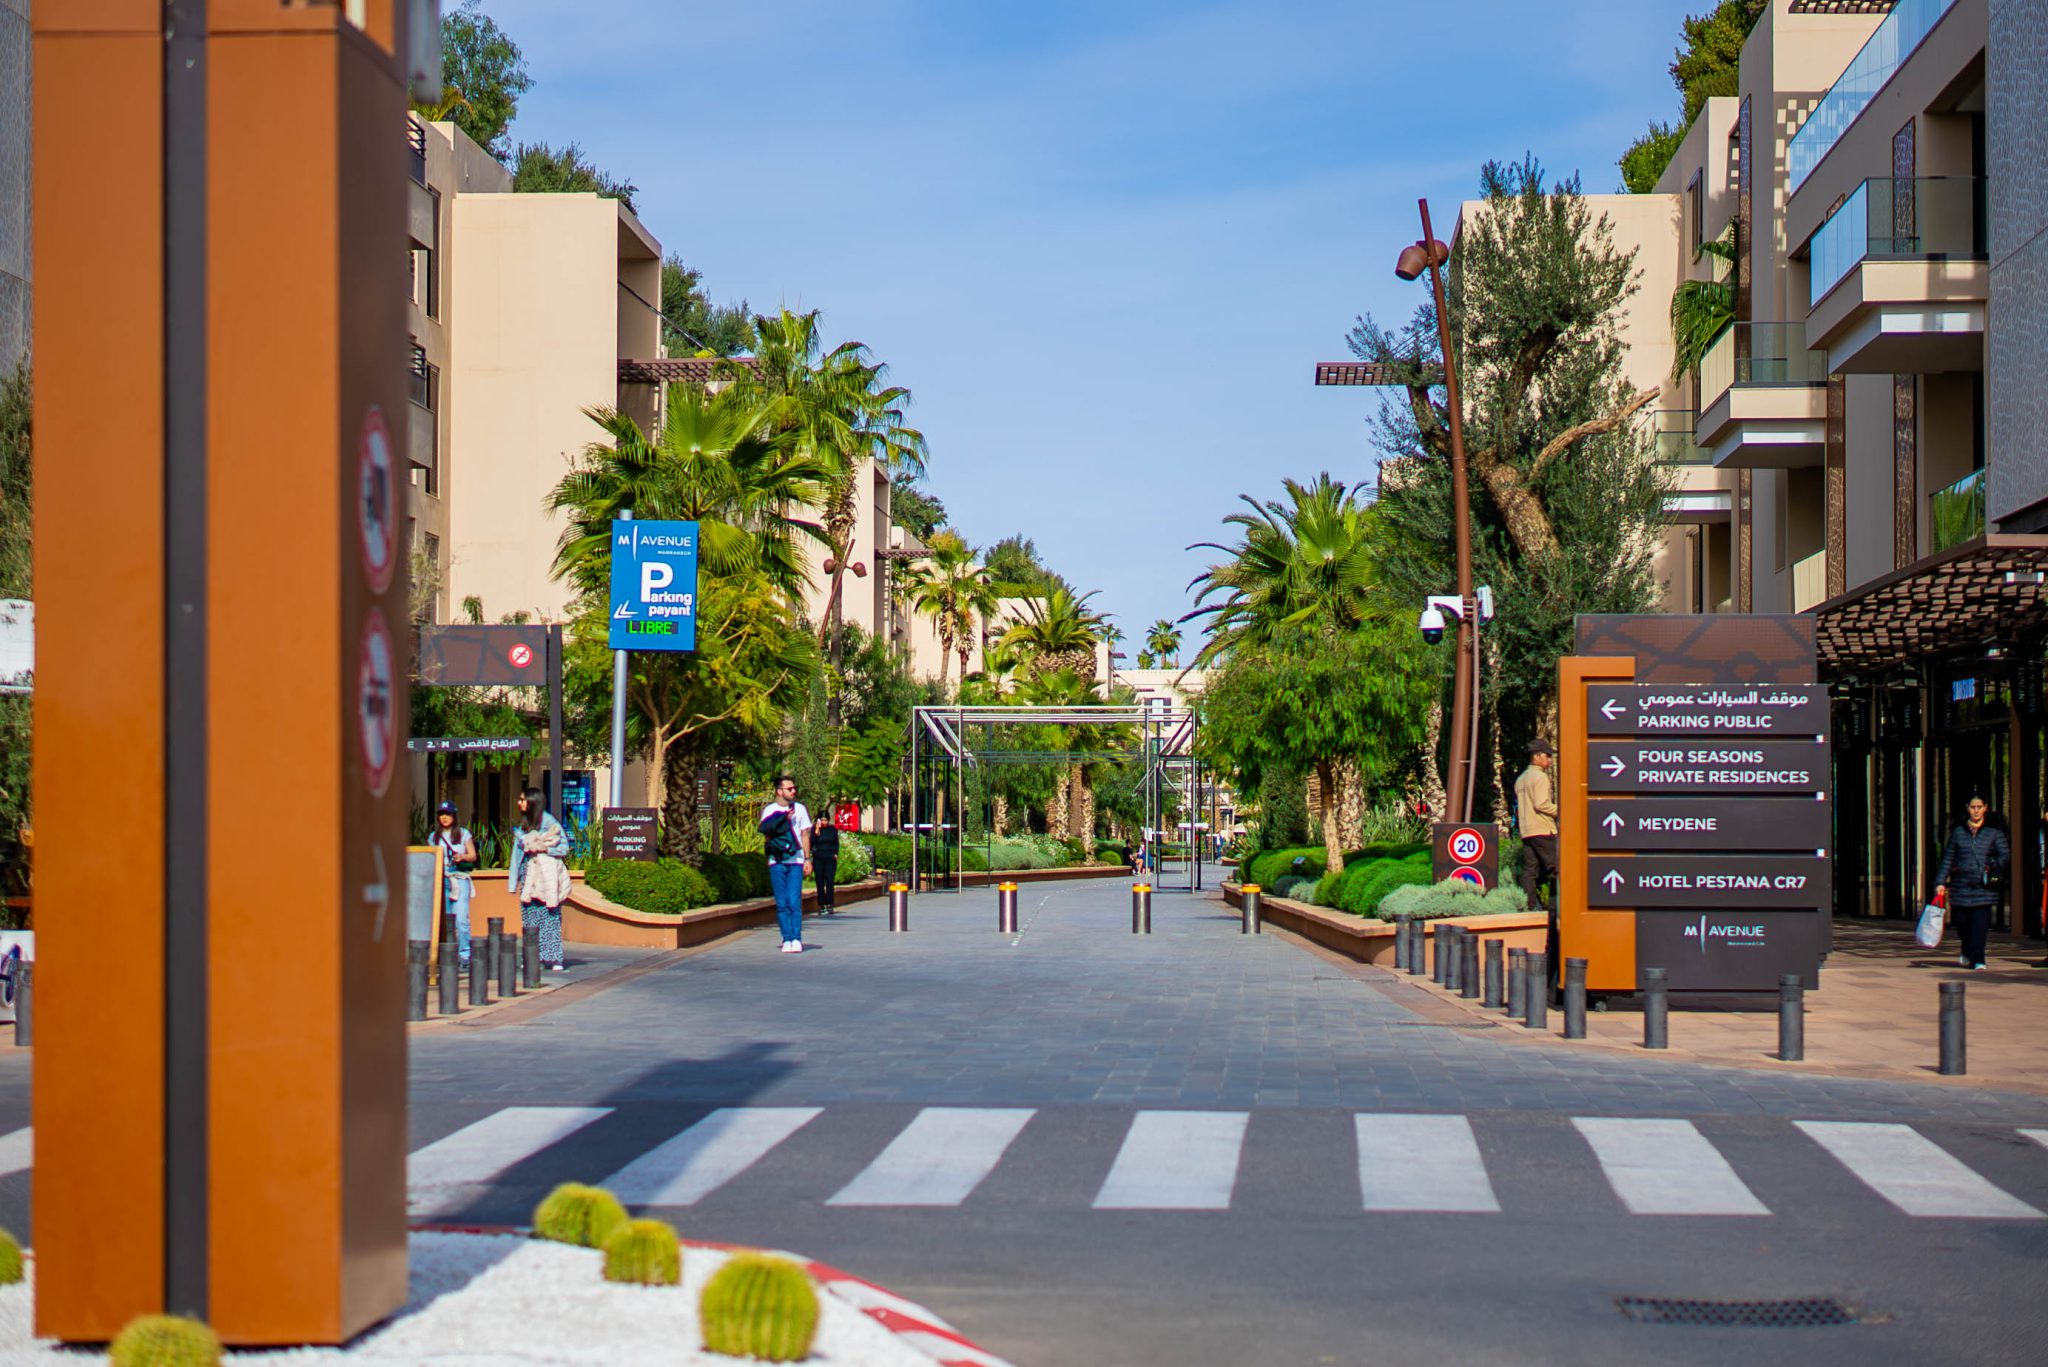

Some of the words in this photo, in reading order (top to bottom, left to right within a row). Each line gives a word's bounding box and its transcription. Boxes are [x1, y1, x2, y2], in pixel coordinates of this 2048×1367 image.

[618, 535, 630, 545] M
[640, 535, 692, 547] AVENUE
[648, 605, 691, 617] payant
[629, 620, 673, 635] LIBRE
[1638, 695, 1695, 711] عمومي
[1697, 691, 1758, 708] السيارات
[1761, 691, 1809, 708] موقف
[1638, 715, 1710, 728] PARKING
[1714, 715, 1773, 728] PUBLIC
[1638, 750, 1684, 763] FOUR
[1687, 750, 1764, 763] SEASONS
[1638, 770, 1705, 783] PRIVATE
[1709, 770, 1810, 783] RESIDENCES
[1638, 818, 1717, 830] MEYDENE
[1457, 839, 1476, 853] 20
[1638, 876, 1692, 888] HOTEL
[1696, 876, 1770, 888] PESTANA
[1774, 876, 1807, 888] CR7
[1684, 925, 1698, 936] M
[1708, 925, 1765, 937] AVENUE
